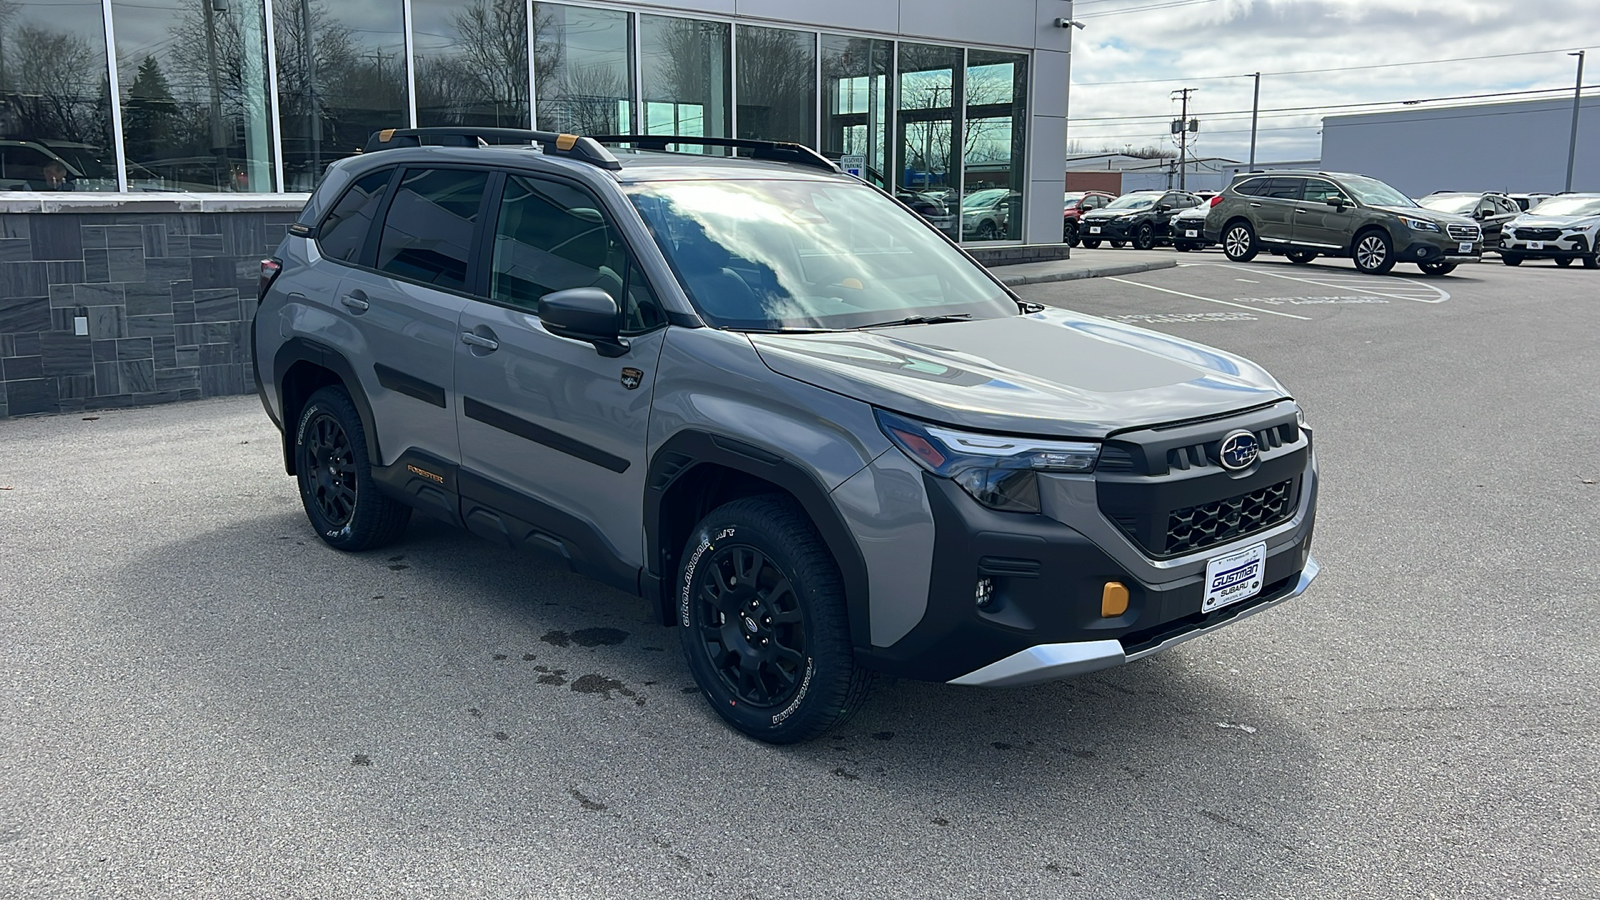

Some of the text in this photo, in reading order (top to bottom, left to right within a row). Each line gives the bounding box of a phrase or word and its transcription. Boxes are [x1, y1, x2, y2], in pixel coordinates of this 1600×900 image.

[407, 464, 443, 483] FORESTER
[1221, 582, 1248, 597] SUBARU
[772, 656, 812, 725] YOKOHAMA
